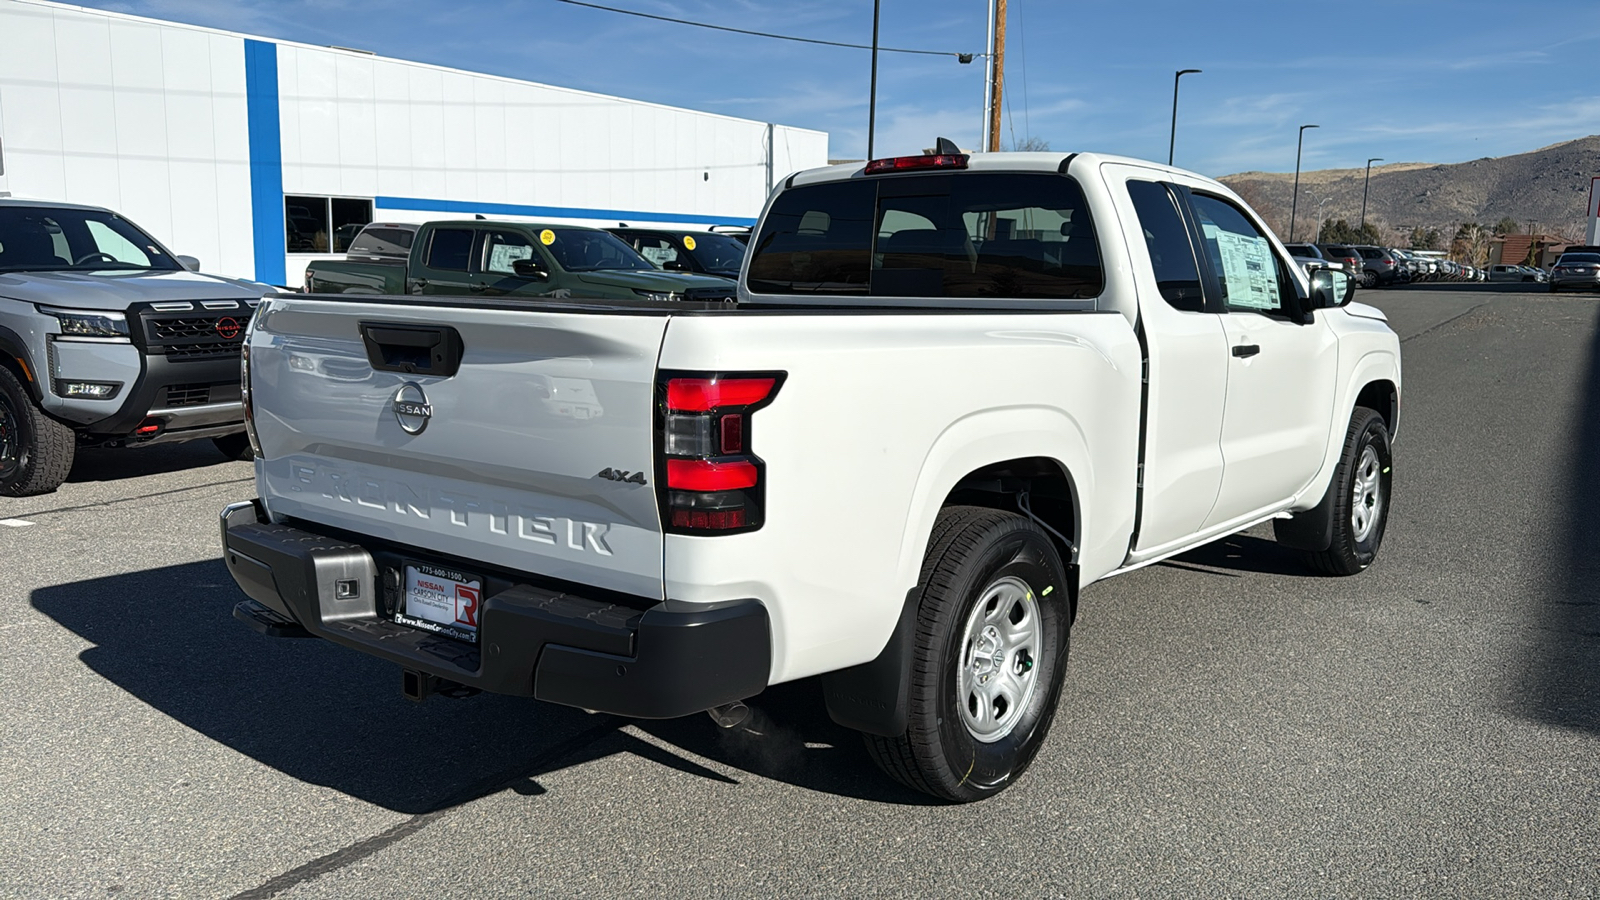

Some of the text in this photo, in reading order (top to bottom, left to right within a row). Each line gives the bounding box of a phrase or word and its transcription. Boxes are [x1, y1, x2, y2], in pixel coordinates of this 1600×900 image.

[392, 400, 430, 416] NISSAN
[289, 459, 614, 557] FRONTIER
[422, 566, 462, 580] 775-600-1500
[417, 580, 444, 592] NISSAN
[413, 587, 450, 602] CARSON CITY
[432, 602, 448, 611] Dealership
